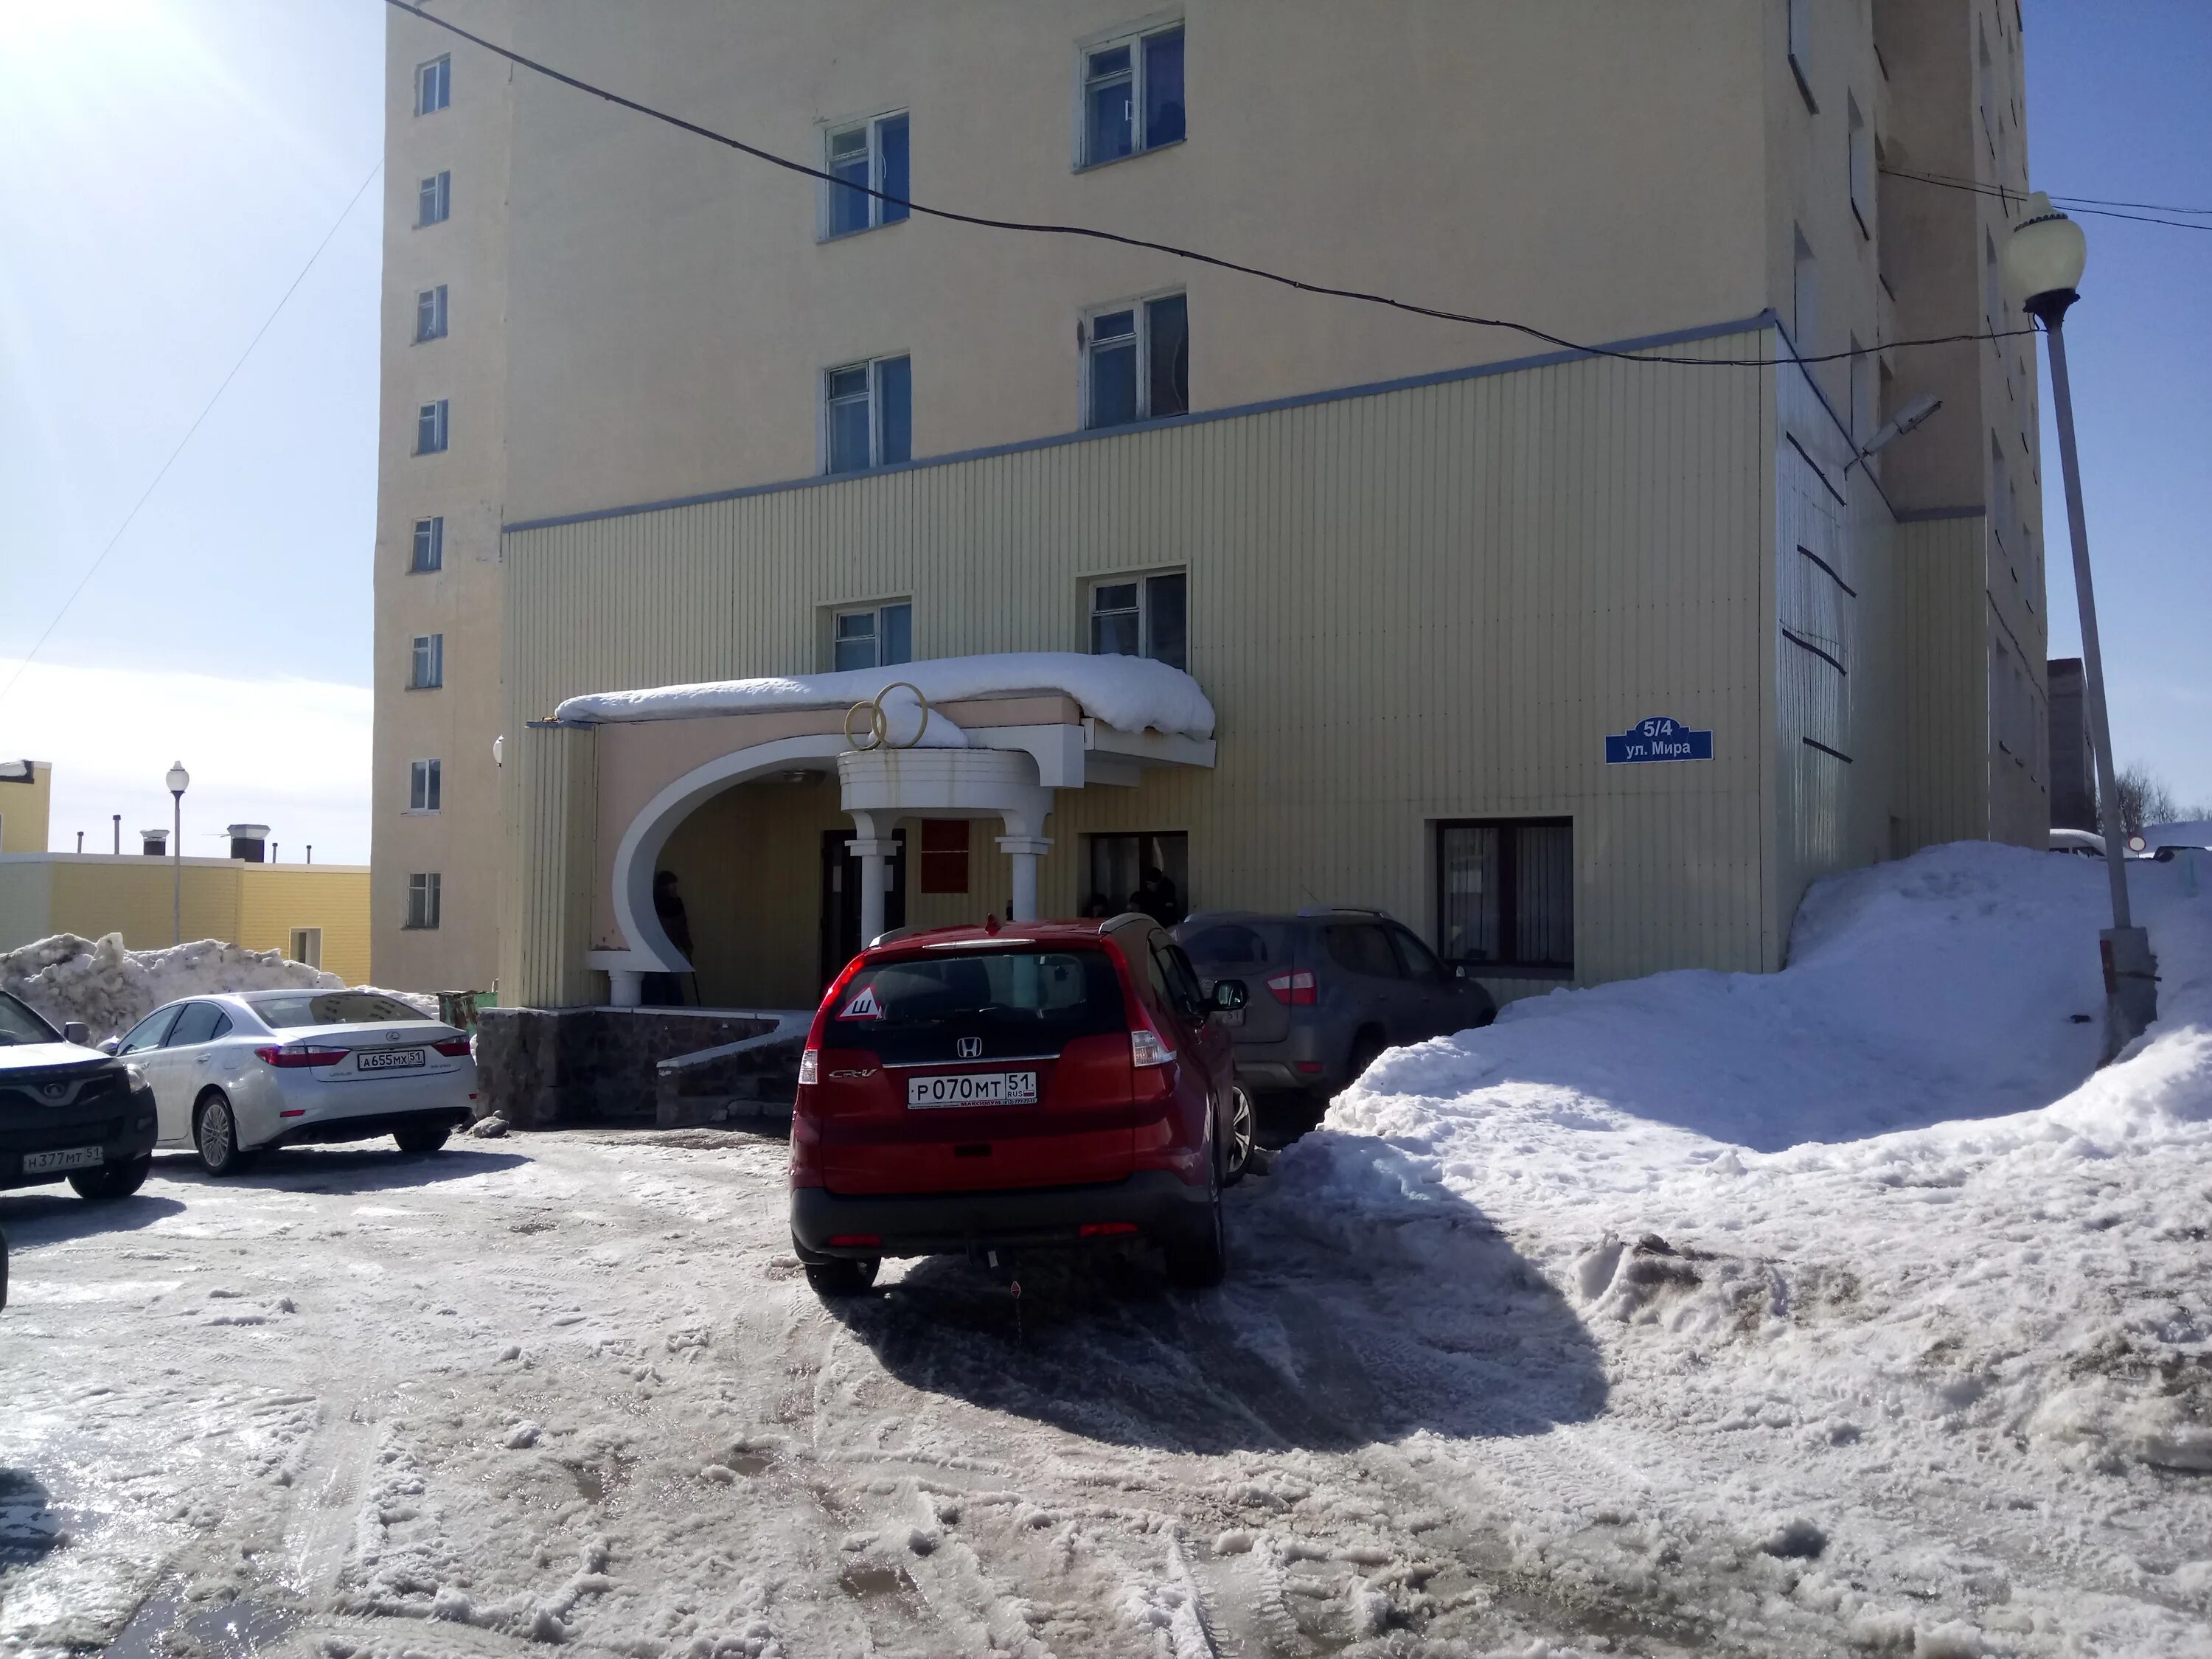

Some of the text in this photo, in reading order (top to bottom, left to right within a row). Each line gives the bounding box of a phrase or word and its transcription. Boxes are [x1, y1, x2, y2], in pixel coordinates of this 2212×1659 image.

[1643, 720, 1673, 737] 5/4
[1625, 741, 1691, 759] ул. Мира
[851, 999, 872, 1015] Ш
[364, 1051, 421, 1068] А655МХ 51
[828, 1068, 877, 1078] CR-V
[917, 1074, 1029, 1101] Р070МТ 51
[1007, 1090, 1023, 1098] RUS
[28, 1147, 100, 1169] Н377МТ 51
